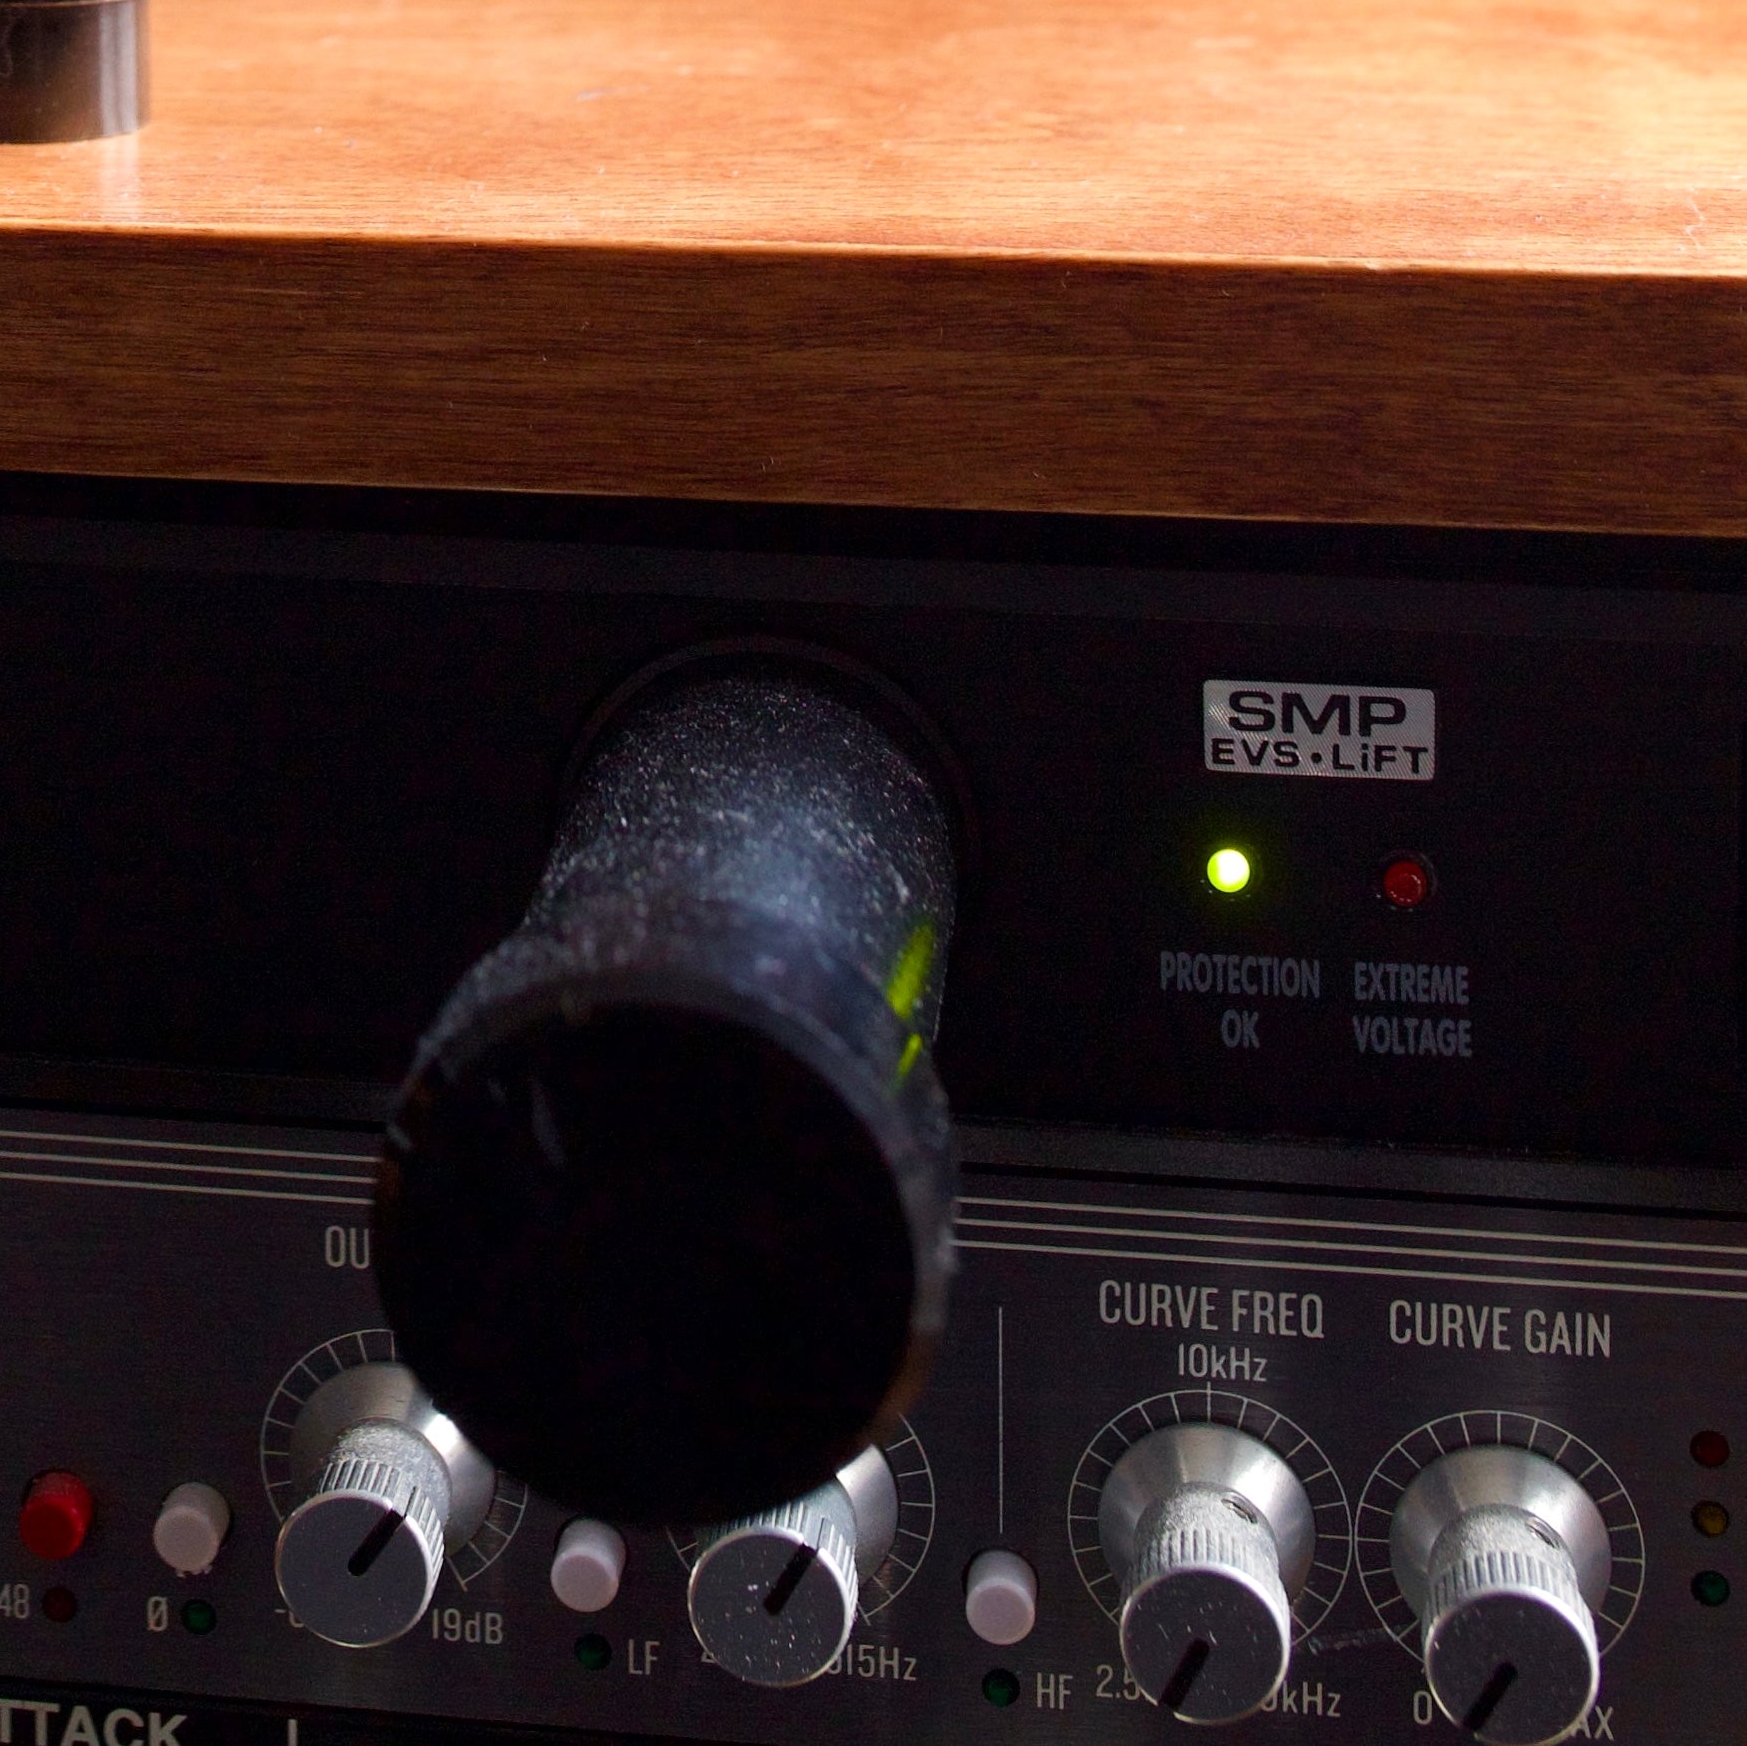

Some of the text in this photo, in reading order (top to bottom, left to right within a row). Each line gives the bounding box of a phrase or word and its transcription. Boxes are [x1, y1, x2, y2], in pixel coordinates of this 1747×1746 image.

[1227, 690, 1407, 737] SMP
[1159, 952, 1321, 999] PROTECTION
[1354, 963, 1470, 1005] EXTREME
[1221, 1011, 1260, 1049] OK
[1353, 1017, 1473, 1058] VOLTAGE
[324, 1225, 371, 1270] OU
[1099, 1279, 1325, 1339] CURVE FREQ
[1388, 1300, 1612, 1359] CURVE GAIN
[1176, 1343, 1268, 1383] 10kHz
[431, 1610, 504, 1646] 19dB
[628, 1638, 660, 1675] LF
[1036, 1673, 1074, 1709] HF
[1095, 1663, 1142, 1701] 2.5
[1260, 1680, 1342, 1718] kHz
[1413, 1690, 1433, 1726] 0
[1570, 1705, 1615, 1742] AX
